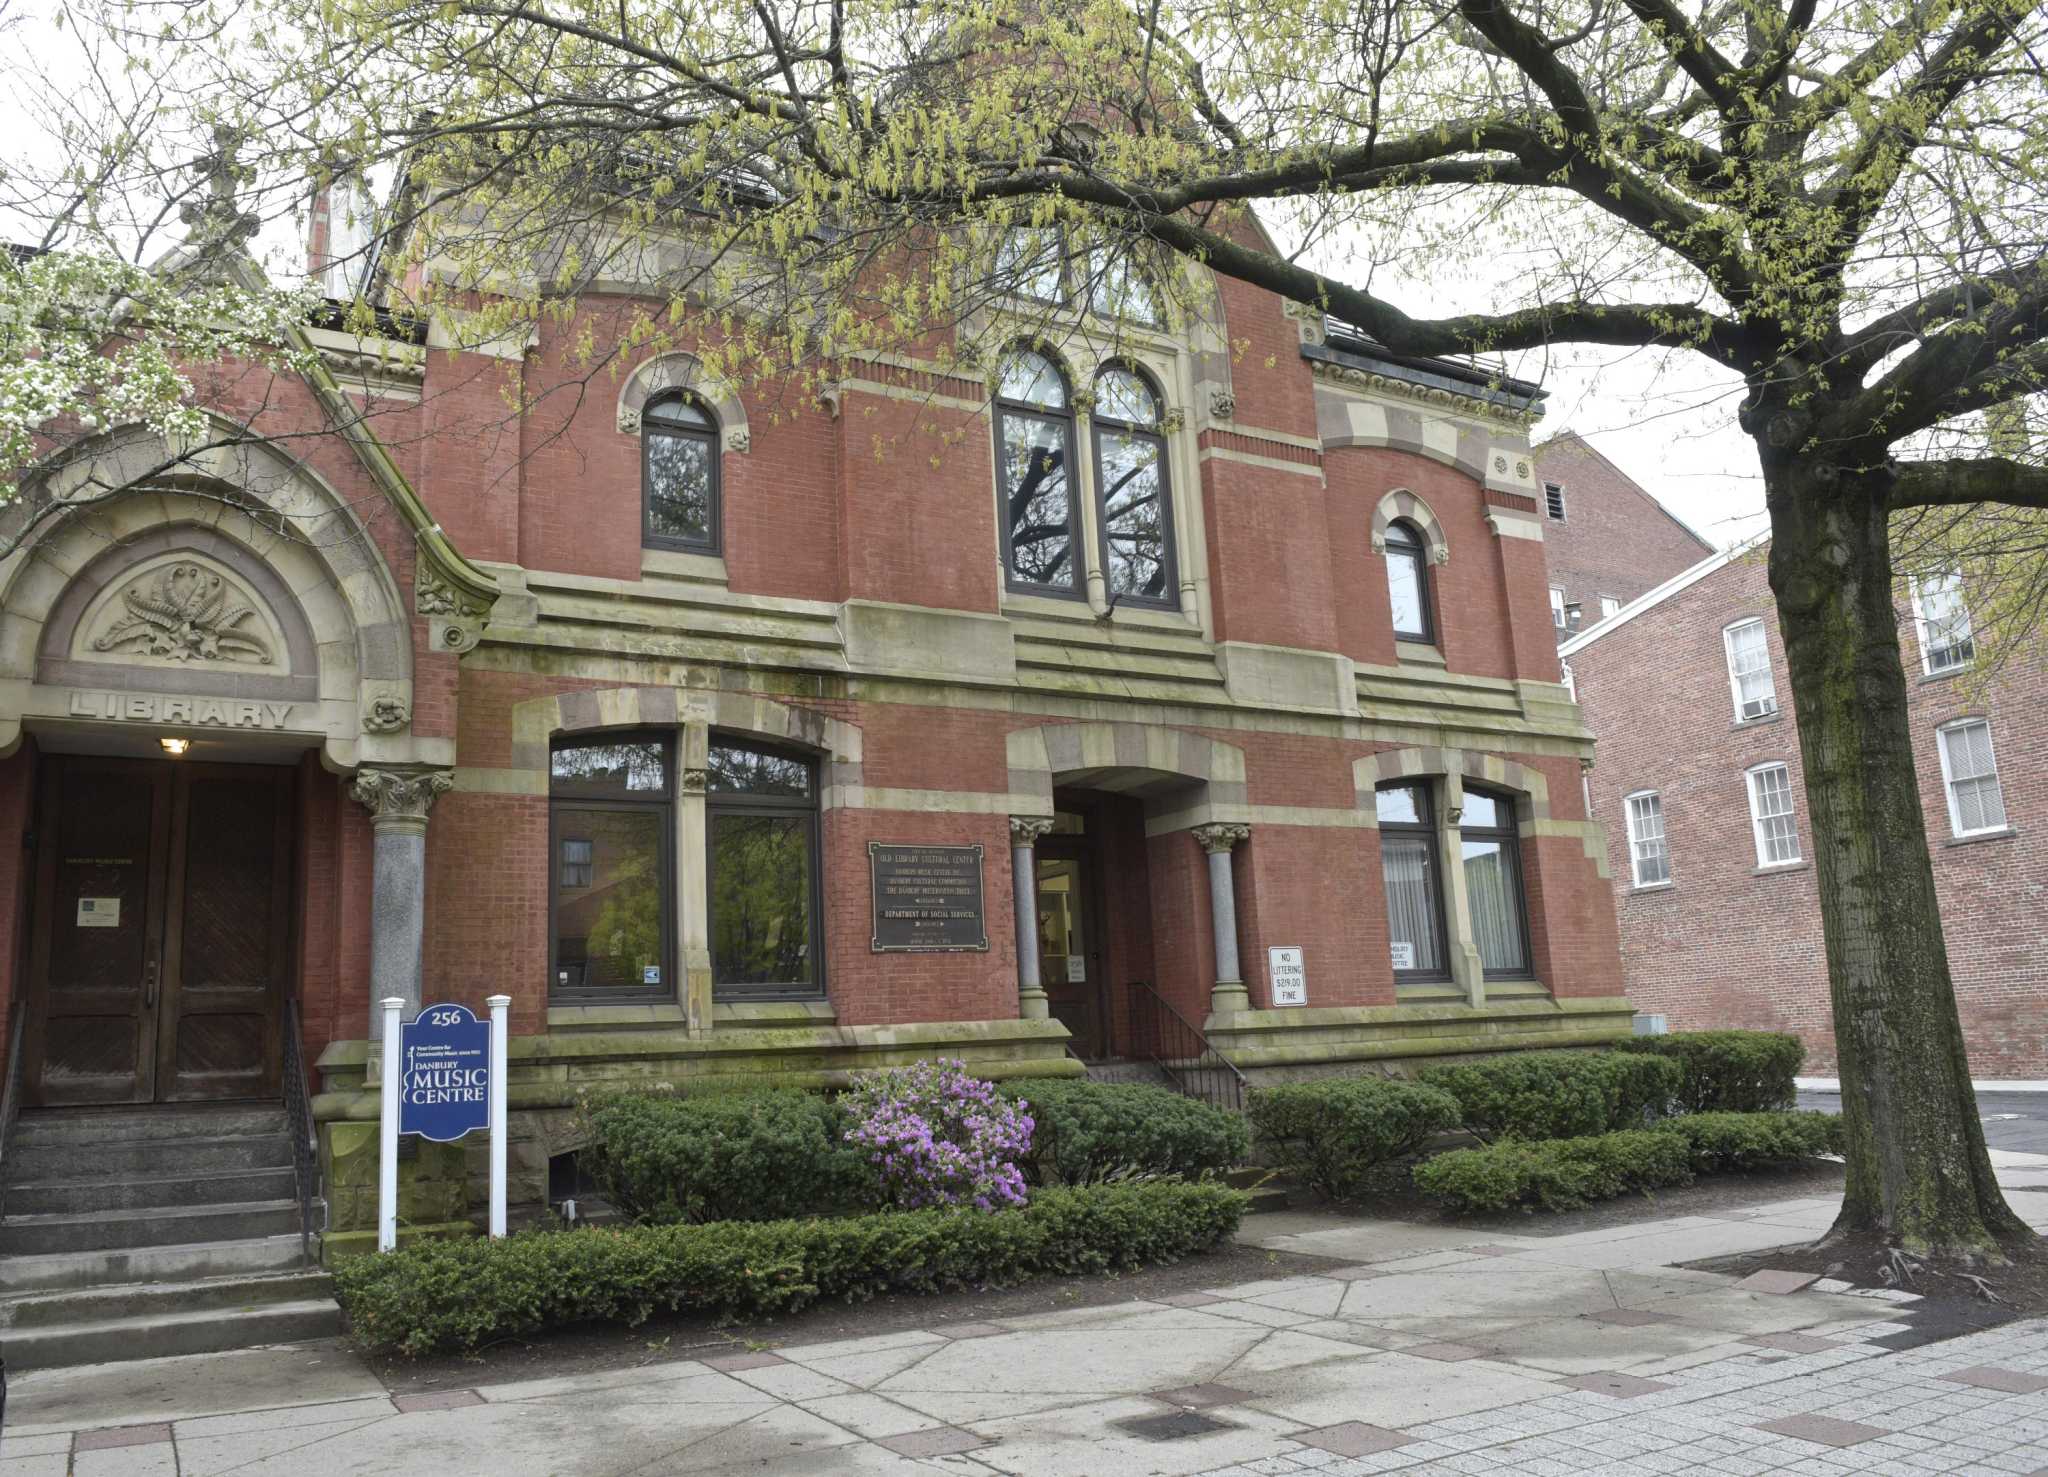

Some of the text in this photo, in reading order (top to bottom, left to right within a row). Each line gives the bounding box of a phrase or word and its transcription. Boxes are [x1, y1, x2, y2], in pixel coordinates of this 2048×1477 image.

[69, 691, 294, 729] LIBRARY
[1281, 953, 1291, 962] NO
[1273, 965, 1302, 975] LITTERING
[1282, 991, 1296, 1000] FINE
[432, 1010, 460, 1026] 256
[415, 1061, 458, 1070] DANBURY
[413, 1068, 487, 1089] MUSIC
[413, 1087, 484, 1104] CENTRE
